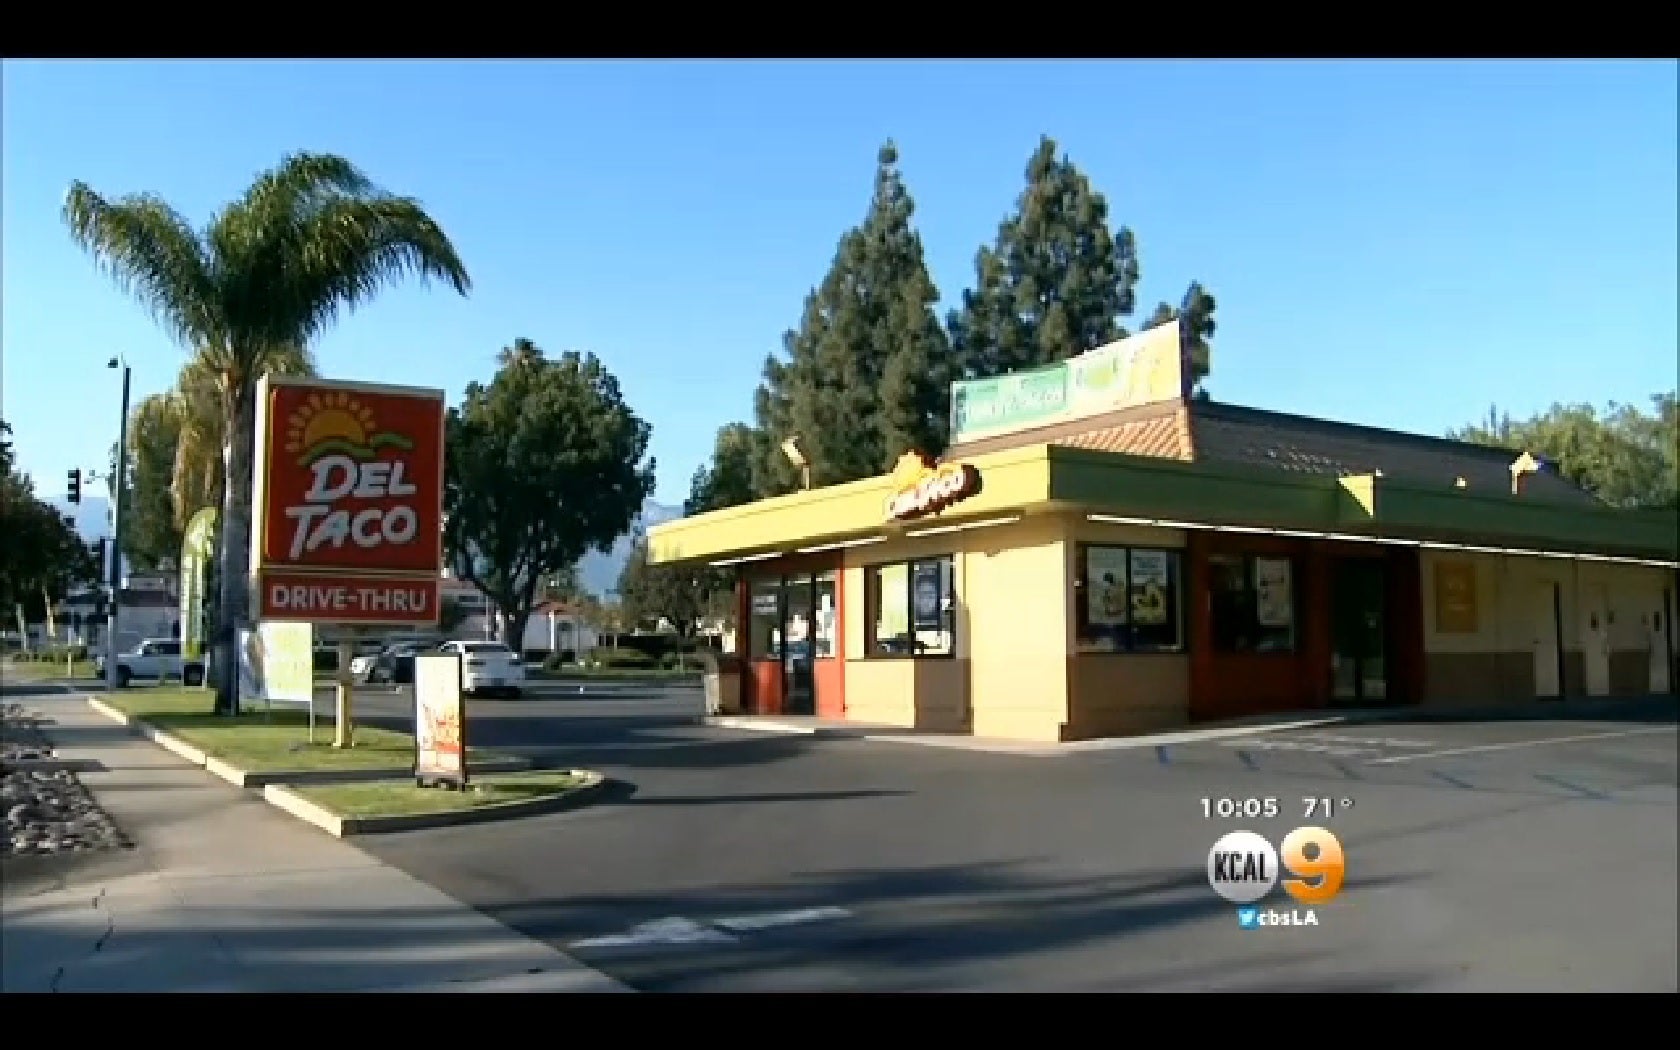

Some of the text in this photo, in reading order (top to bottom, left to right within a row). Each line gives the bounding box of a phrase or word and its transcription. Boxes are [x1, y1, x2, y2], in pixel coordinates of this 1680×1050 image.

[305, 455, 417, 502] DEL
[285, 505, 418, 559] TACO
[272, 585, 426, 612] DRIVE-THRU
